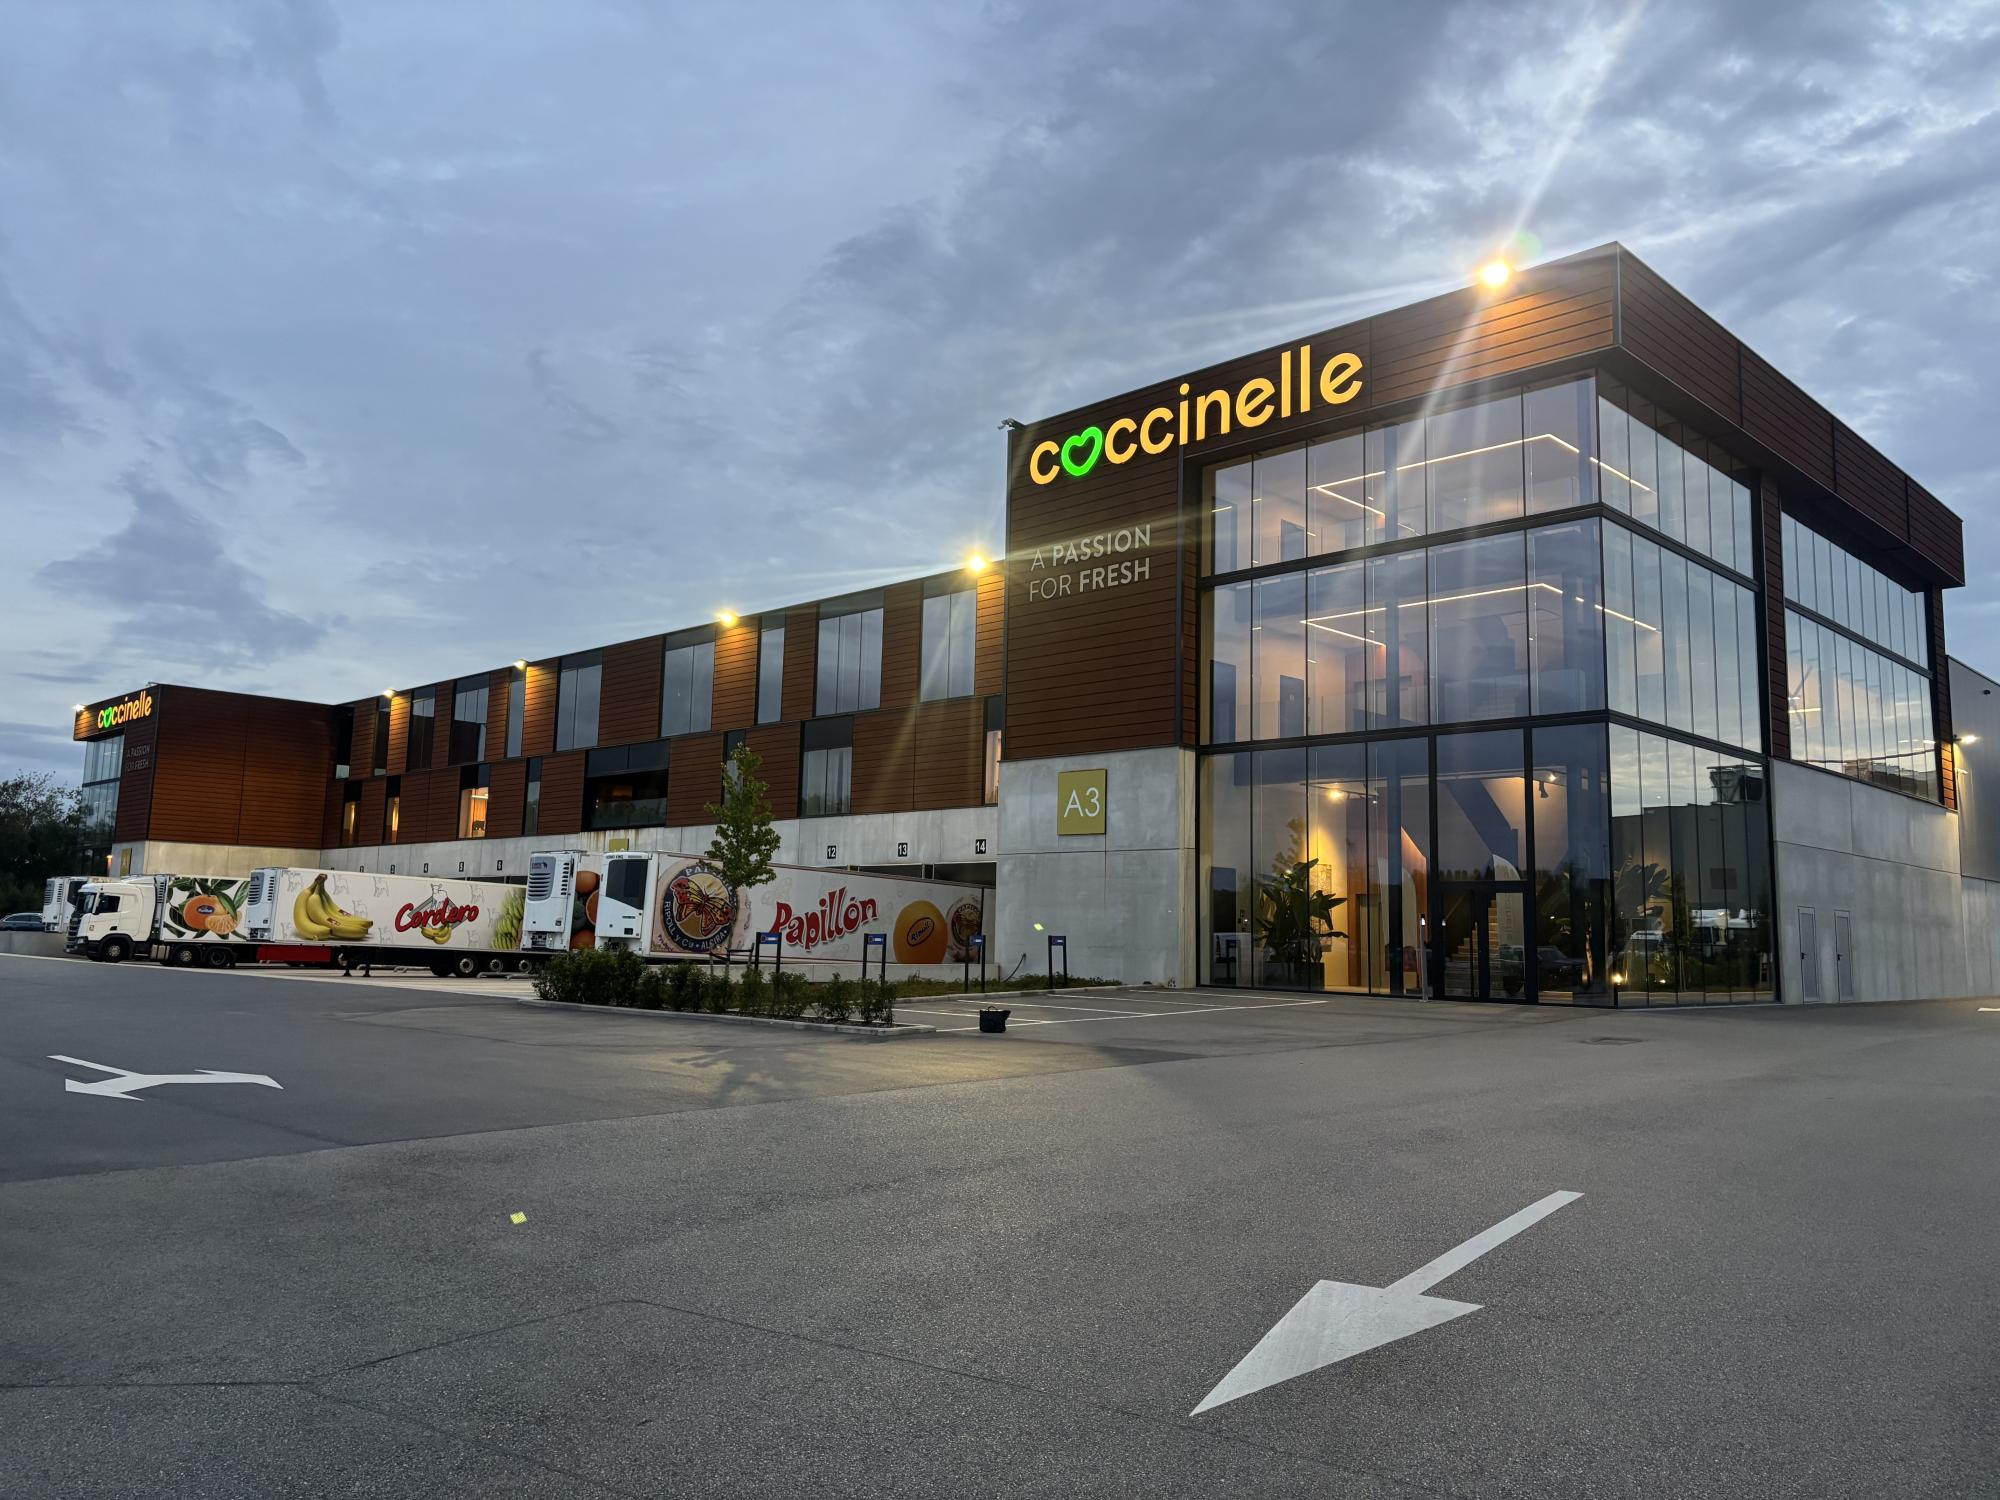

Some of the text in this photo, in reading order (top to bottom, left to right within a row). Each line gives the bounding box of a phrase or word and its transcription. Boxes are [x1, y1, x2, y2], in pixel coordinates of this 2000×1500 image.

[1029, 344, 1363, 485] coccinelle
[1030, 524, 1151, 571] A PASSION
[1029, 557, 1150, 602] FOR FRESH
[1063, 787, 1100, 818] A3
[827, 846, 836, 858] 12
[898, 844, 907, 856] 13
[975, 840, 986, 853] 14
[395, 896, 480, 933] Cordero
[664, 901, 676, 936] RIPOLL
[700, 932, 726, 950] ALCIRA
[769, 886, 878, 952] Papillón
